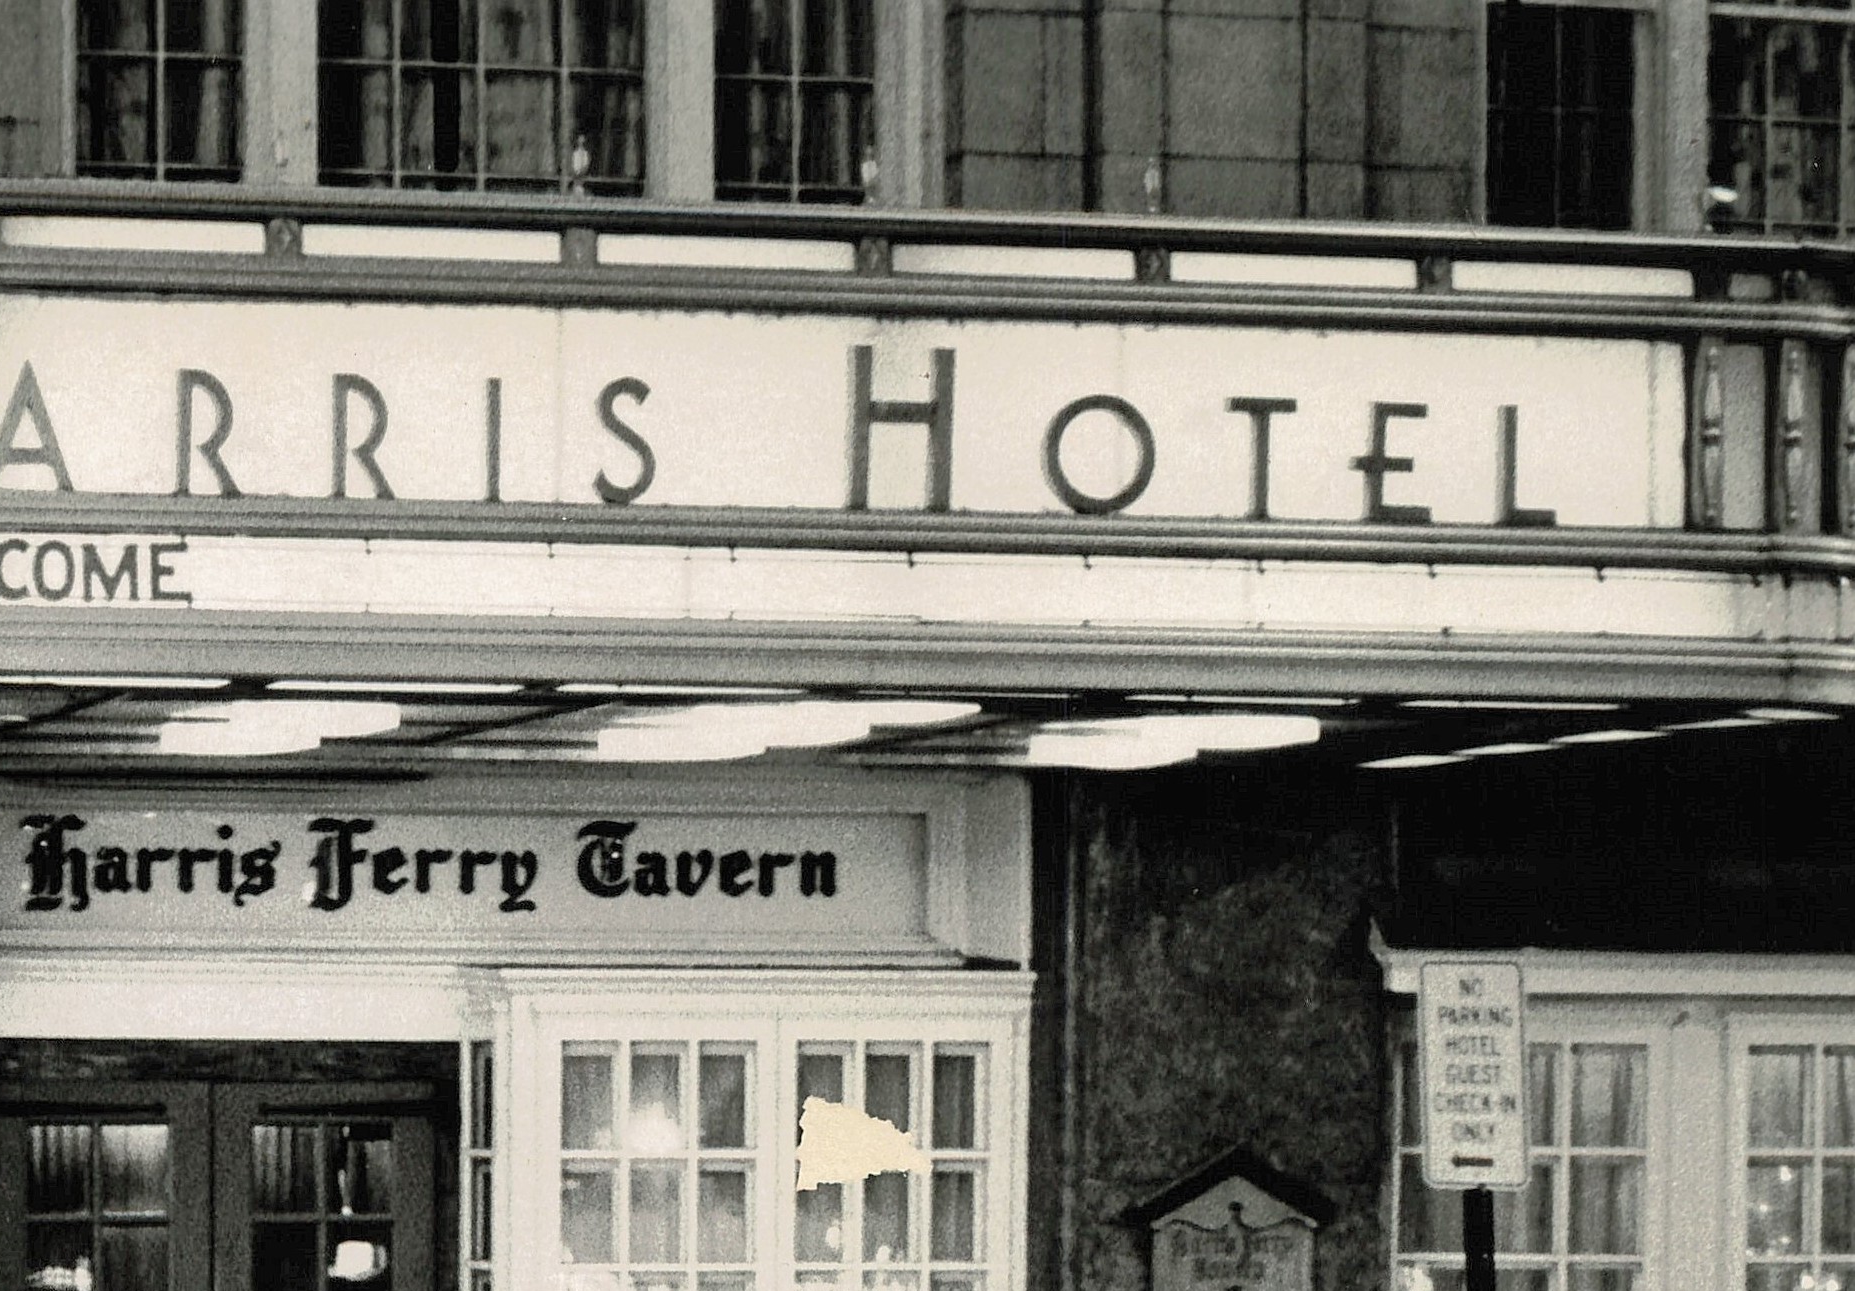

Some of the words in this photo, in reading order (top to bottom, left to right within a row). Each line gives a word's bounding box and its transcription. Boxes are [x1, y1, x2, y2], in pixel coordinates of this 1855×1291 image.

[847, 344, 1557, 527] HOTEL
[19, 813, 281, 912] Harris
[308, 817, 539, 912] Ferry
[576, 820, 837, 898] Tavern
[1458, 977, 1484, 997] NO
[1437, 1005, 1514, 1027] PARKING
[1445, 1035, 1501, 1057] HOTEL
[1445, 1064, 1501, 1085] GUEST
[1433, 1092, 1517, 1113] CHECK-IN
[1451, 1121, 1496, 1143] ONLY
